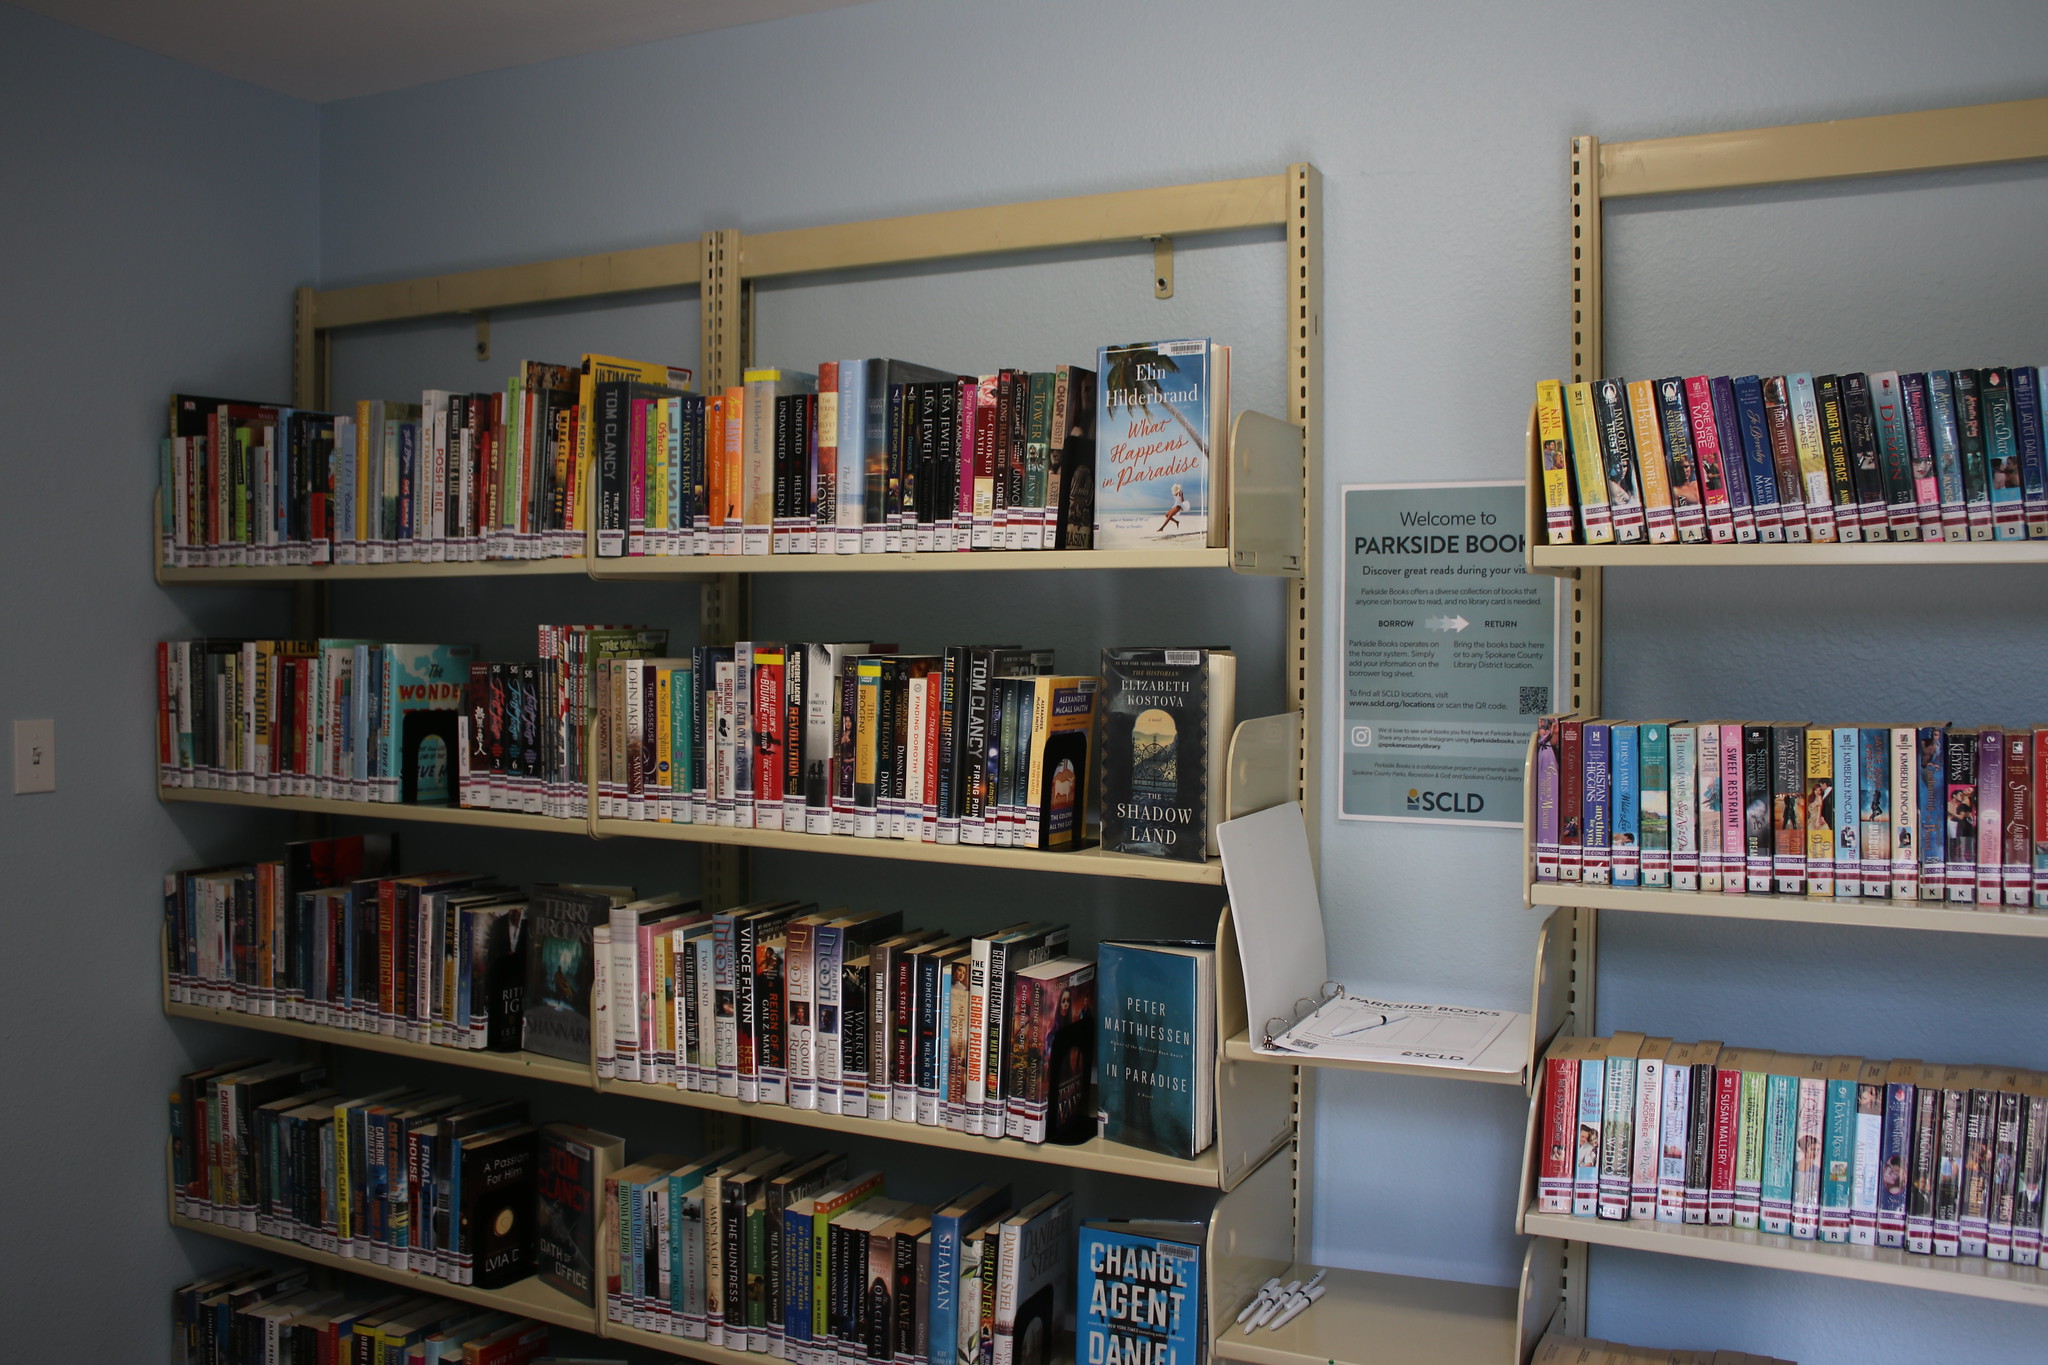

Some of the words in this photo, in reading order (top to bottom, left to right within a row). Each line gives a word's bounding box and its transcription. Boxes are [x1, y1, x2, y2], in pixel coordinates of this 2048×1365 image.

[1136, 363, 1167, 381] Elin
[606, 389, 617, 421] TOM
[941, 388, 950, 413] LISA
[1000, 399, 1008, 421] LONG
[1106, 384, 1199, 407] Hilderbrand
[778, 401, 786, 459] UNDAUNTED
[794, 399, 802, 454] UNDEFEATED
[1128, 418, 1172, 439] What
[1540, 406, 1550, 435] AMOS
[1551, 409, 1560, 429] KIM
[1637, 409, 1653, 448] BELLA
[1693, 405, 1707, 448] MORE
[1701, 402, 1709, 424] ONE
[1706, 426, 1715, 449] KISS
[1773, 408, 1785, 429] HARD
[1803, 401, 1819, 460] SAMANTHA
[1825, 402, 1839, 429] UNDER
[938, 417, 950, 462] JEWELL
[999, 423, 1007, 447] HARD
[1606, 422, 1618, 453] TRUST
[1613, 408, 1629, 462] IMMORTAL
[1777, 431, 1789, 454] HITTER
[1797, 414, 1809, 449] CHASE
[1830, 431, 1843, 445] THE
[1880, 405, 1901, 480] DEMON
[604, 423, 617, 479] CLANCY
[998, 449, 1006, 468] RIDE
[1110, 436, 1189, 467] Happens
[1832, 448, 1848, 481] SURFACE
[1102, 477, 1114, 488] in
[1116, 456, 1200, 492] Paradise
[1643, 451, 1657, 489] ANDRE
[1400, 512, 1476, 526] Welcome
[1481, 513, 1496, 525] to
[1355, 535, 1459, 554] PARKSIDE
[1466, 534, 1526, 553] BOO
[1363, 566, 1401, 575] Discover
[1404, 566, 1426, 578] great
[1430, 565, 1454, 575] reads
[1457, 565, 1487, 577] during
[1490, 567, 1510, 577] your
[1514, 565, 1527, 574] vis
[1427, 598, 1443, 606] read,
[1469, 598, 1489, 606] library
[1400, 641, 1429, 649] operates
[1411, 651, 1435, 659] Simply
[1454, 641, 1472, 650] Bring
[1485, 652, 1515, 660] Spokane
[1517, 652, 1543, 660] County
[628, 667, 637, 699] JOHN
[971, 658, 987, 691] TOM
[1121, 680, 1190, 692] ELIZABETH
[1382, 671, 1393, 679] log
[255, 652, 267, 735] ATTENTION
[1127, 695, 1184, 707] KOSTOVA
[1401, 691, 1433, 699] locations,
[628, 703, 637, 734] JAKES
[969, 696, 984, 758] CLANCY
[788, 707, 799, 776] REVOLUTION
[1727, 749, 1738, 776] SWEET
[1900, 753, 1909, 790] KIMBERLY
[1587, 762, 1596, 802] HIGGINS
[1595, 762, 1606, 802] KRISTAN
[1117, 803, 1193, 824] SHADOW
[1422, 791, 1484, 813] SCLD
[1727, 781, 1739, 828] RESTRAINT
[1900, 791, 1909, 825] KINCAID
[1131, 826, 1177, 845] LAND
[741, 928, 751, 972] VINCE
[972, 960, 984, 968] THE
[971, 970, 983, 987] CUT
[741, 977, 752, 1024] FLYNN
[970, 995, 983, 1030] GEORGE
[1127, 997, 1166, 1017] PETER
[1350, 996, 1435, 1010] PARKSIDE
[1438, 1006, 1501, 1016] BOOKS
[1105, 1017, 1190, 1046] MATTHIESSEN
[968, 1032, 981, 1082] PELECANOS
[1412, 1052, 1464, 1061] SCLD
[1106, 1063, 1117, 1077] IN
[1126, 1067, 1187, 1092] PARADISE
[1720, 1094, 1730, 1123] SUSAN
[409, 1137, 417, 1182] HOUSE
[1717, 1126, 1727, 1165] MALLERY
[421, 1145, 430, 1187] FINAL
[728, 1218, 737, 1239] THE
[1002, 1232, 1016, 1280] DANIELLE
[1090, 1242, 1187, 1288] CHANGE
[728, 1242, 738, 1303] HUNTRESS
[937, 1235, 951, 1311] SHAMAN
[999, 1282, 1013, 1312] STEEL
[1089, 1279, 1185, 1330] AGENT
